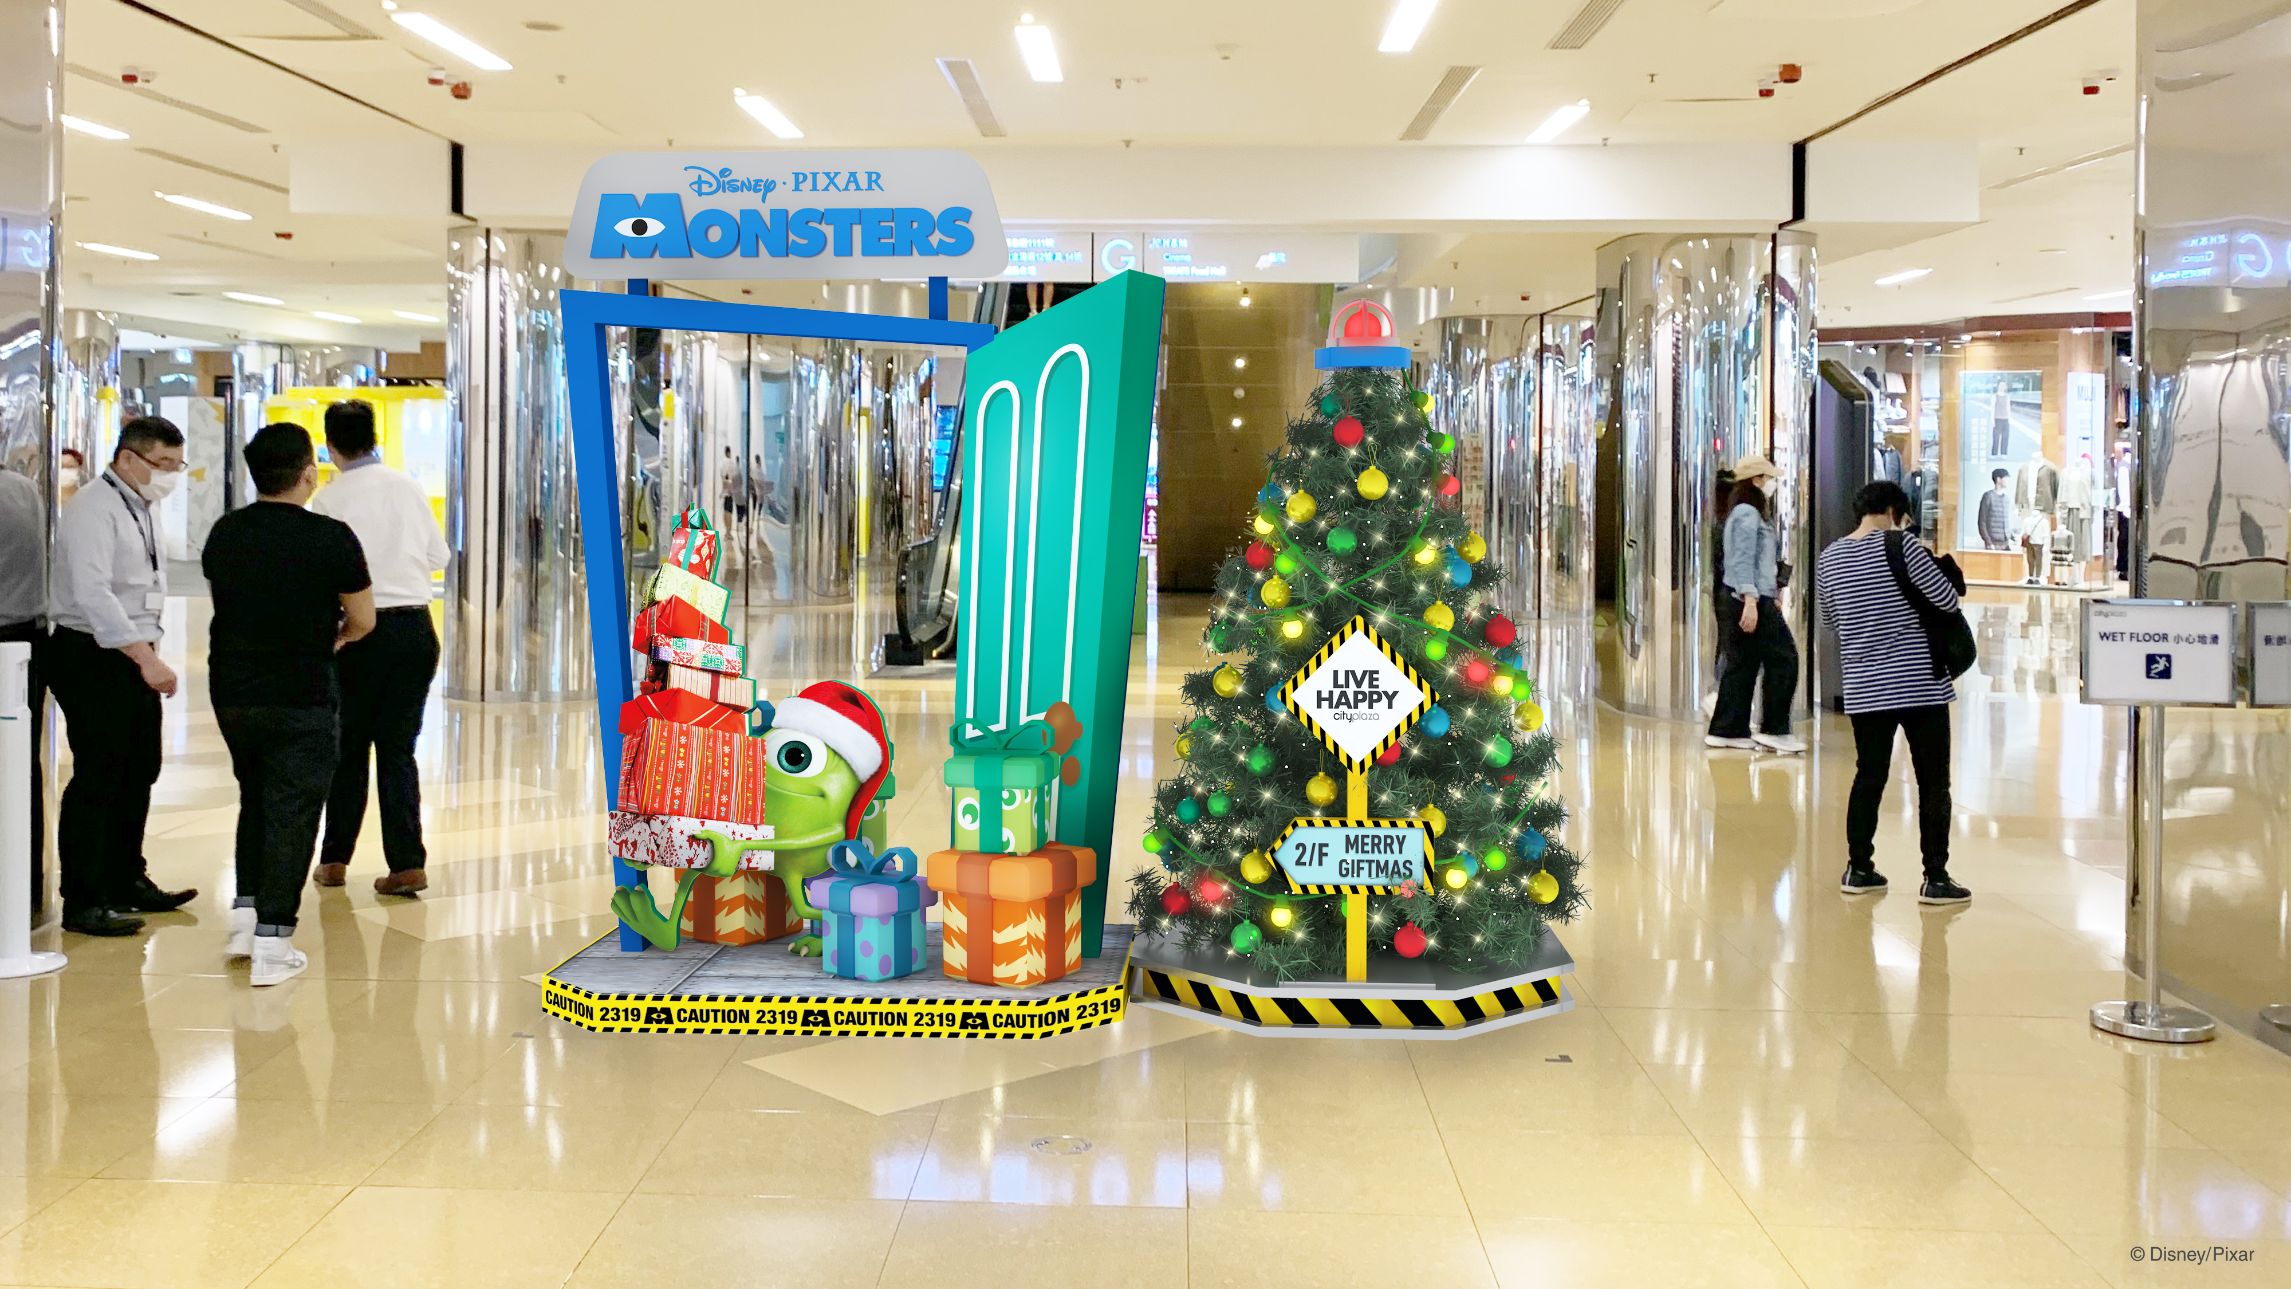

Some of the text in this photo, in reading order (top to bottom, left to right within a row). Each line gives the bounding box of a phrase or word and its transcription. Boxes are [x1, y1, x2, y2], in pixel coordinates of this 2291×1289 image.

[791, 171, 885, 193] PIXAR
[590, 193, 975, 260] MONSTERS
[1101, 238, 1136, 277] G
[2098, 632, 2126, 642] WET
[2129, 632, 2169, 643] FLOOR
[1332, 669, 1380, 689] LIVE
[1316, 690, 1400, 710] HAPPY
[1333, 710, 1380, 723] cityplaza
[1294, 842, 1330, 867] 2/F
[1344, 834, 1407, 855] MERRY
[1338, 859, 1413, 879] GIFTMAS
[545, 989, 594, 1021] CAUTION
[599, 1007, 641, 1022] 2319
[676, 1008, 750, 1024] CAUTION
[756, 1009, 798, 1025] 2319
[834, 1010, 908, 1026] CAUTION
[914, 1011, 956, 1027] 2319
[992, 1008, 1070, 1029] CAUTION
[1076, 997, 1121, 1018] 2319
